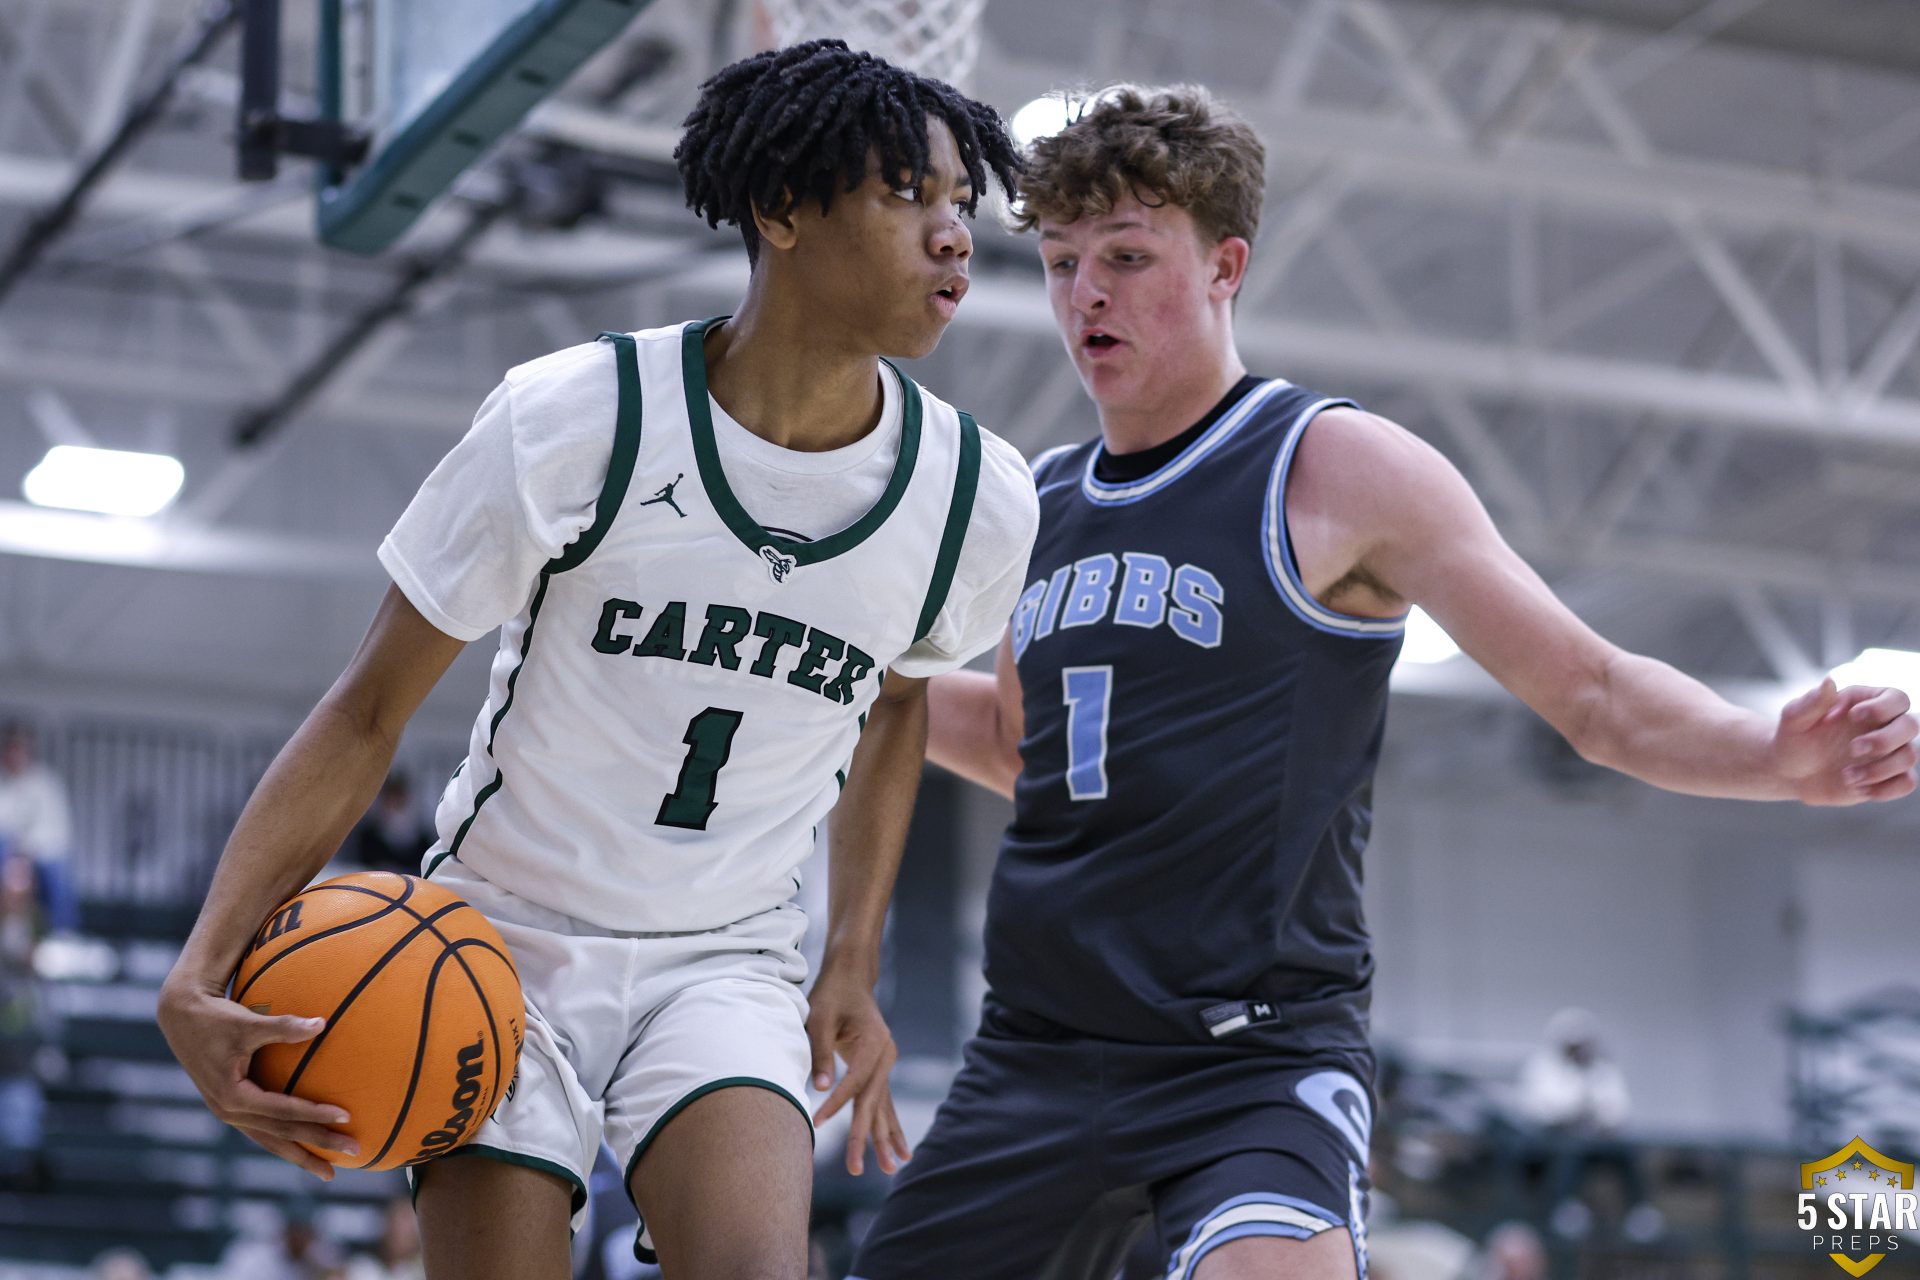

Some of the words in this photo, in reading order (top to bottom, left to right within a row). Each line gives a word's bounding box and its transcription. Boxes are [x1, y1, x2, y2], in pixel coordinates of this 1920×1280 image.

[591, 598, 875, 705] CARTER
[1012, 552, 1224, 664] GIBBS
[654, 707, 744, 831] 1
[1062, 665, 1113, 801] 1
